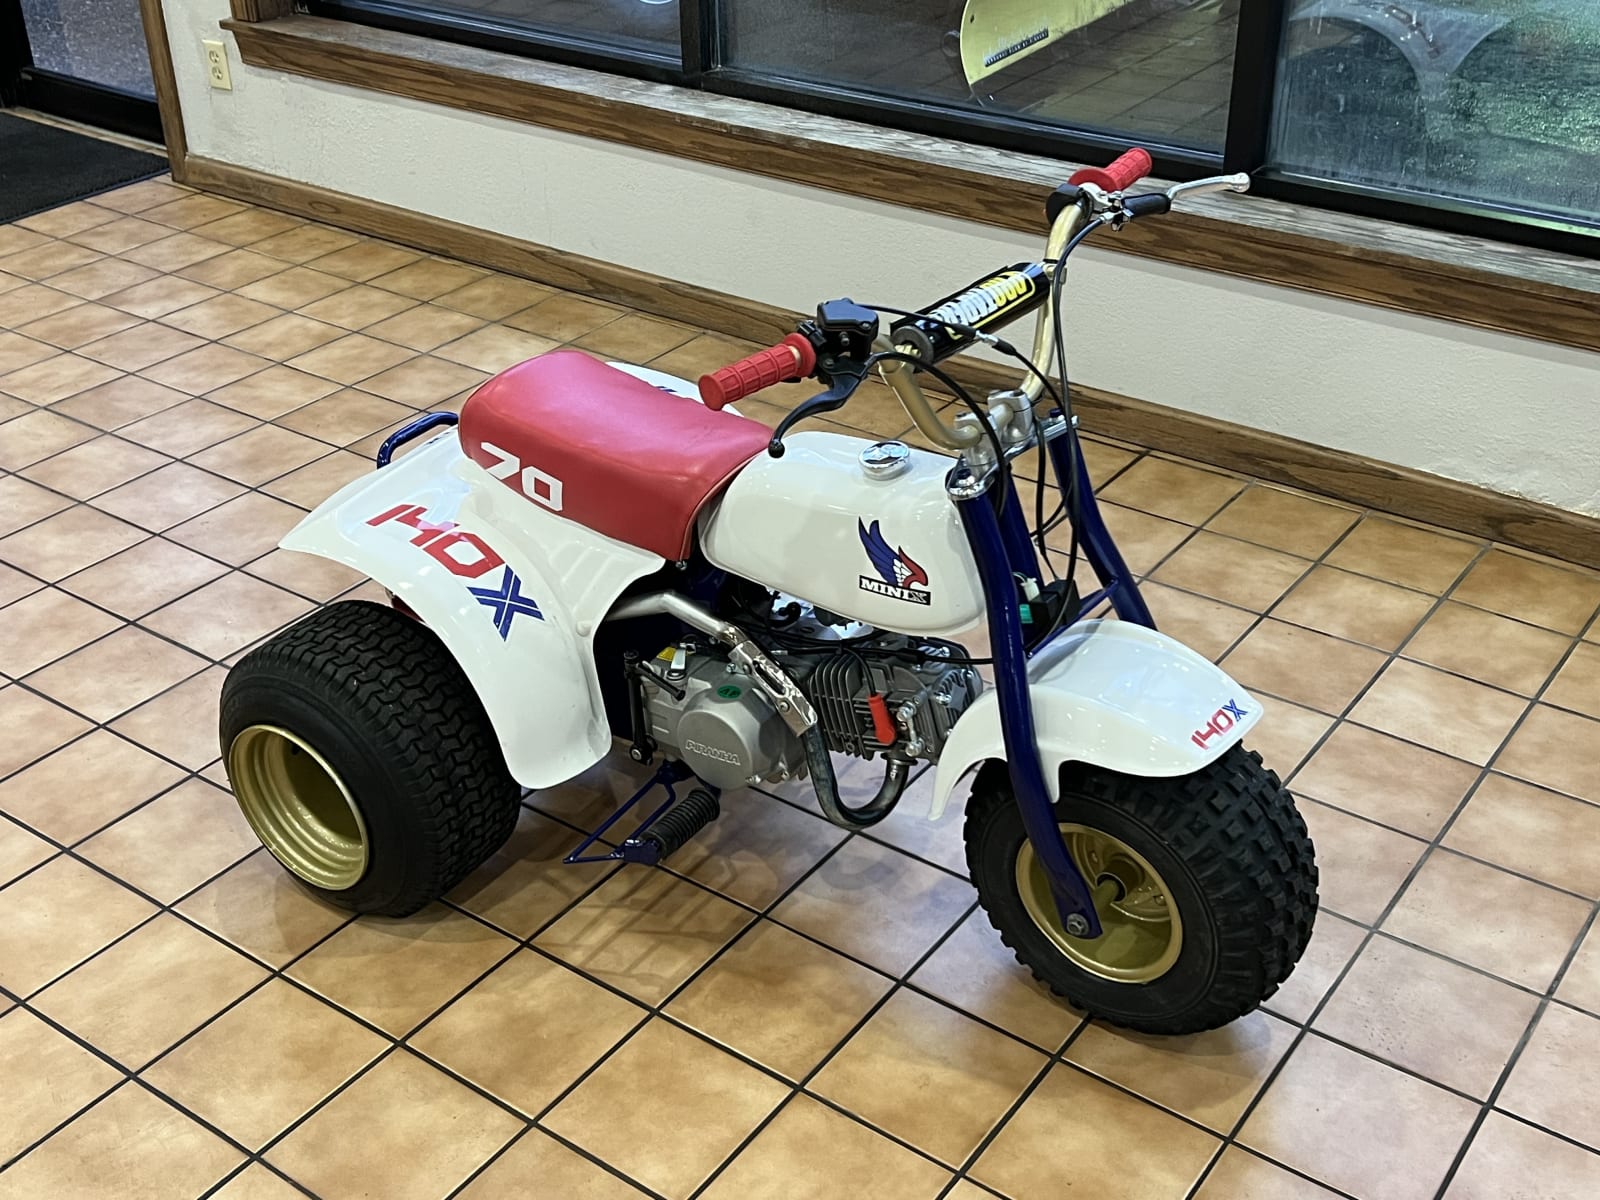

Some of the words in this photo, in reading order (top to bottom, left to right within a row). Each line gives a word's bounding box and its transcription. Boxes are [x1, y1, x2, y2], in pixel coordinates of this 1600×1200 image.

[481, 442, 563, 512] 70
[1191, 698, 1248, 750] 140X
[685, 739, 741, 766] PIRANHA
